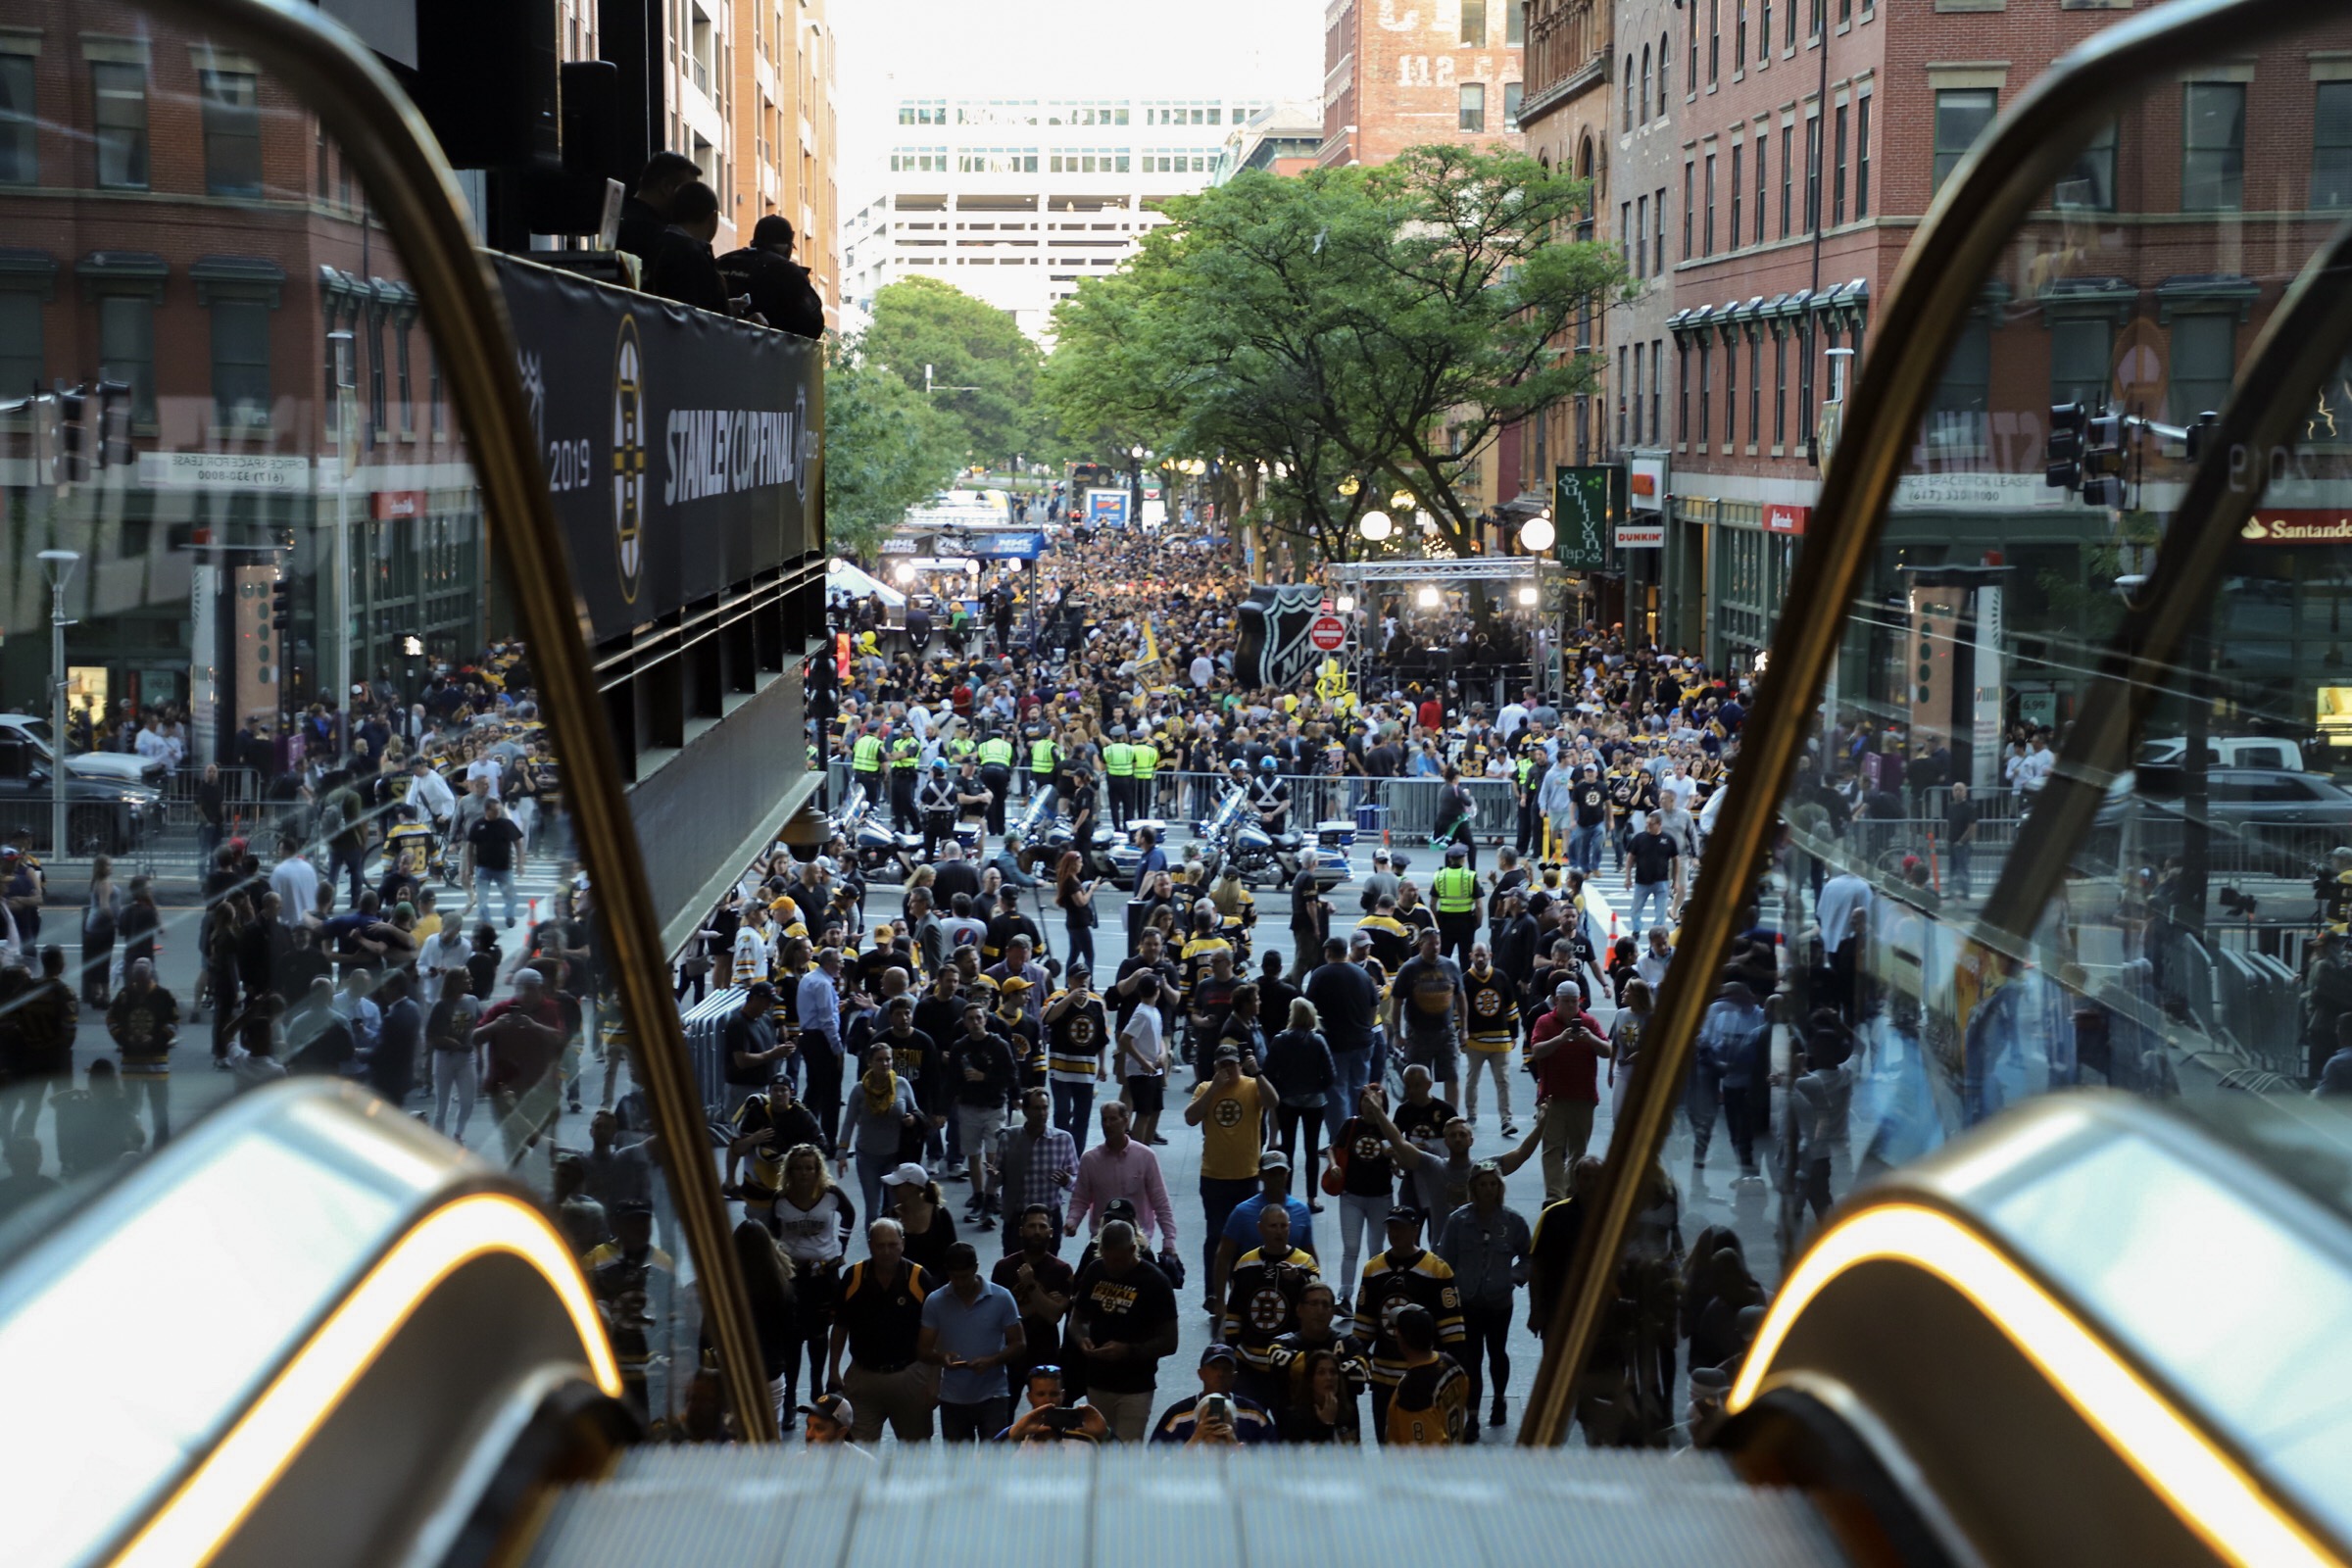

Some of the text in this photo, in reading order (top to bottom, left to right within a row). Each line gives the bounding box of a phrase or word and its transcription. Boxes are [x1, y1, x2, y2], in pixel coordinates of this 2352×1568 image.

[1396, 54, 1455, 87] 112
[550, 438, 590, 492] 2019
[664, 409, 795, 506] STANLEY CUP FINAL
[1993, 476, 2032, 488] LEASE
[1618, 532, 1663, 542] DUNKIN'
[2271, 518, 2352, 538] Santande
[1558, 544, 1586, 564] Tap
[1095, 1286, 1133, 1301] FINAL
[1333, 1340, 1346, 1354] A
